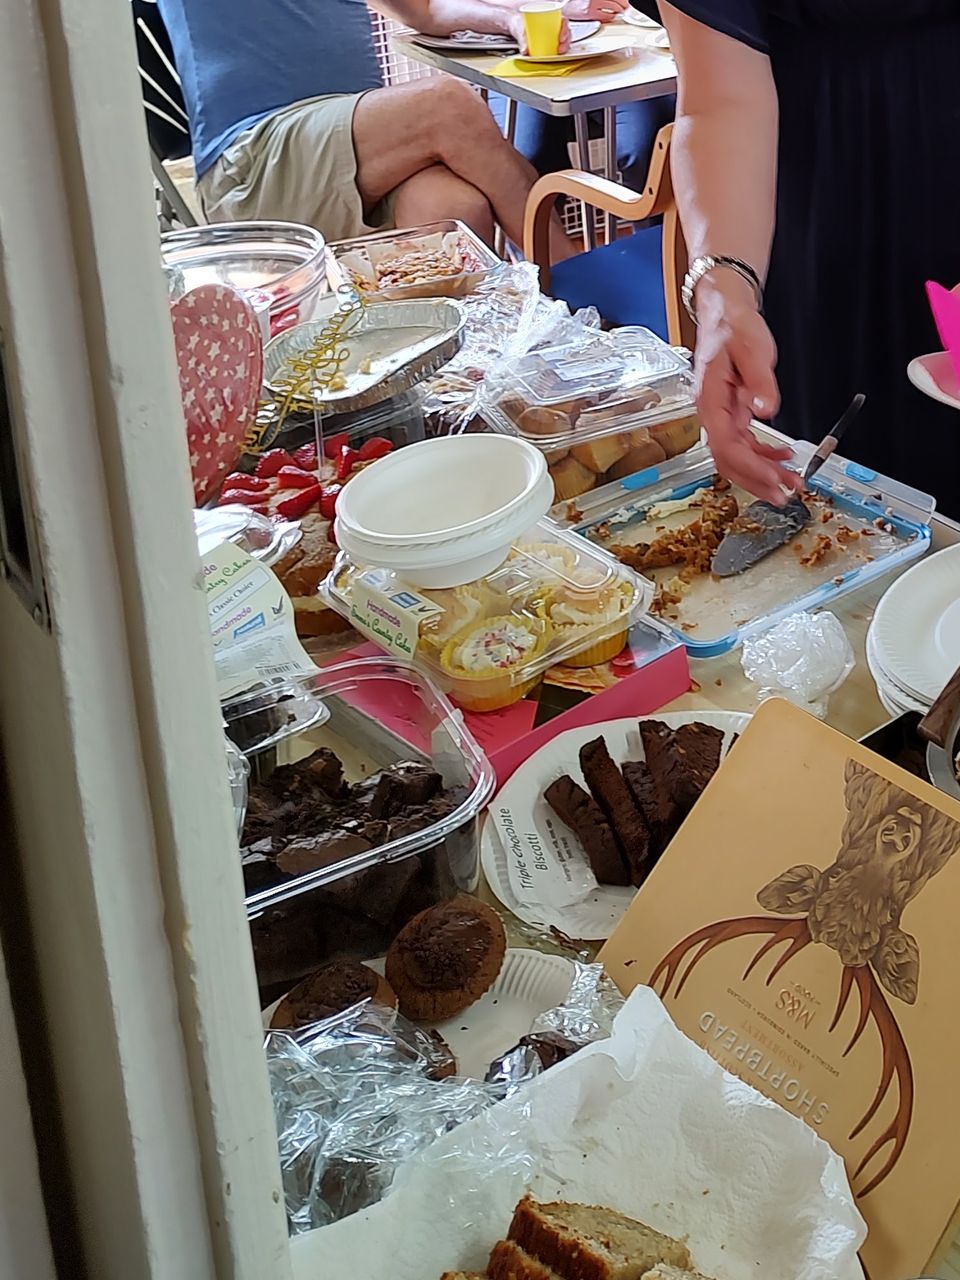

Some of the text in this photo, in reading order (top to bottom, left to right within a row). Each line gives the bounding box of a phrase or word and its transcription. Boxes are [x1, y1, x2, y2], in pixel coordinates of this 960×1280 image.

[234, 581, 255, 598] Choice
[211, 606, 252, 636] andmade
[366, 599, 401, 628] Handmade
[524, 833, 549, 871] Biscotti
[514, 860, 535, 889] Triple
[775, 988, 816, 1030] M&S
